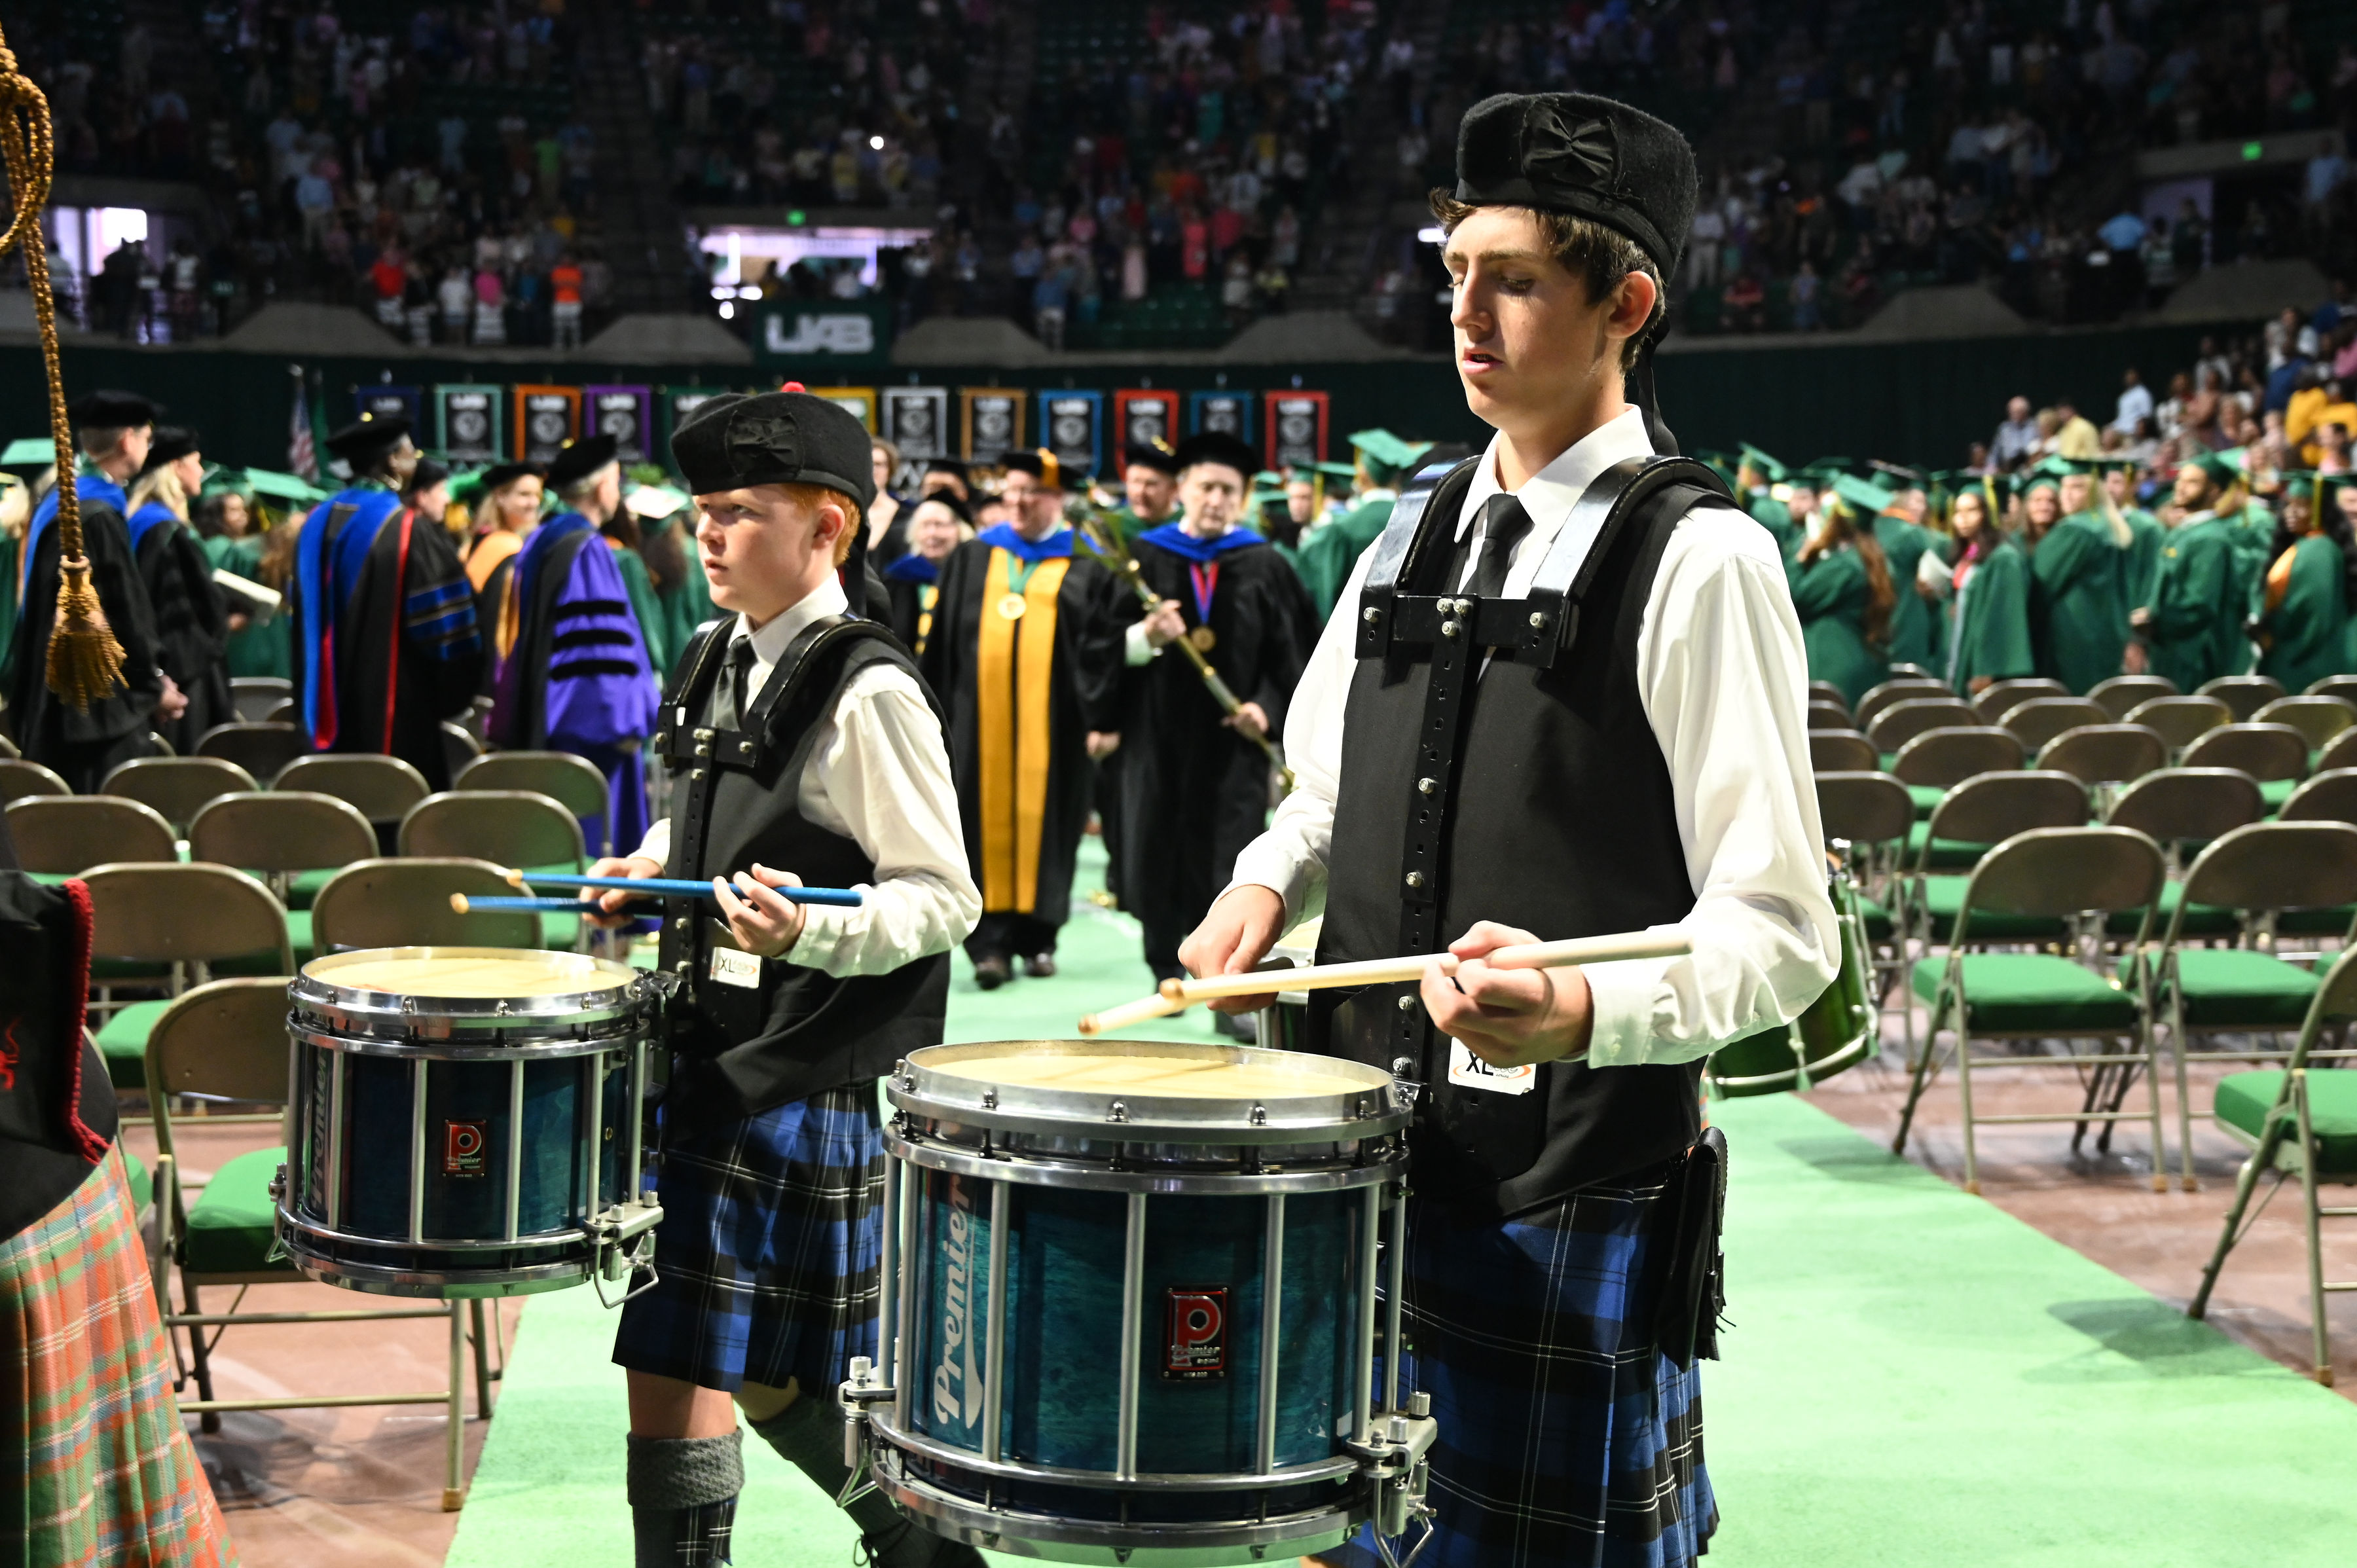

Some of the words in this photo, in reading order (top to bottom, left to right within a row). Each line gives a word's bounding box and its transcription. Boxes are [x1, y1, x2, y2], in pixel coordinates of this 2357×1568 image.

[765, 314, 873, 353] UAB
[720, 957, 735, 974] XL
[1466, 1050, 1493, 1076] XL
[448, 1124, 482, 1171] P
[934, 1174, 969, 1424] Premier
[1172, 1295, 1222, 1366] P
